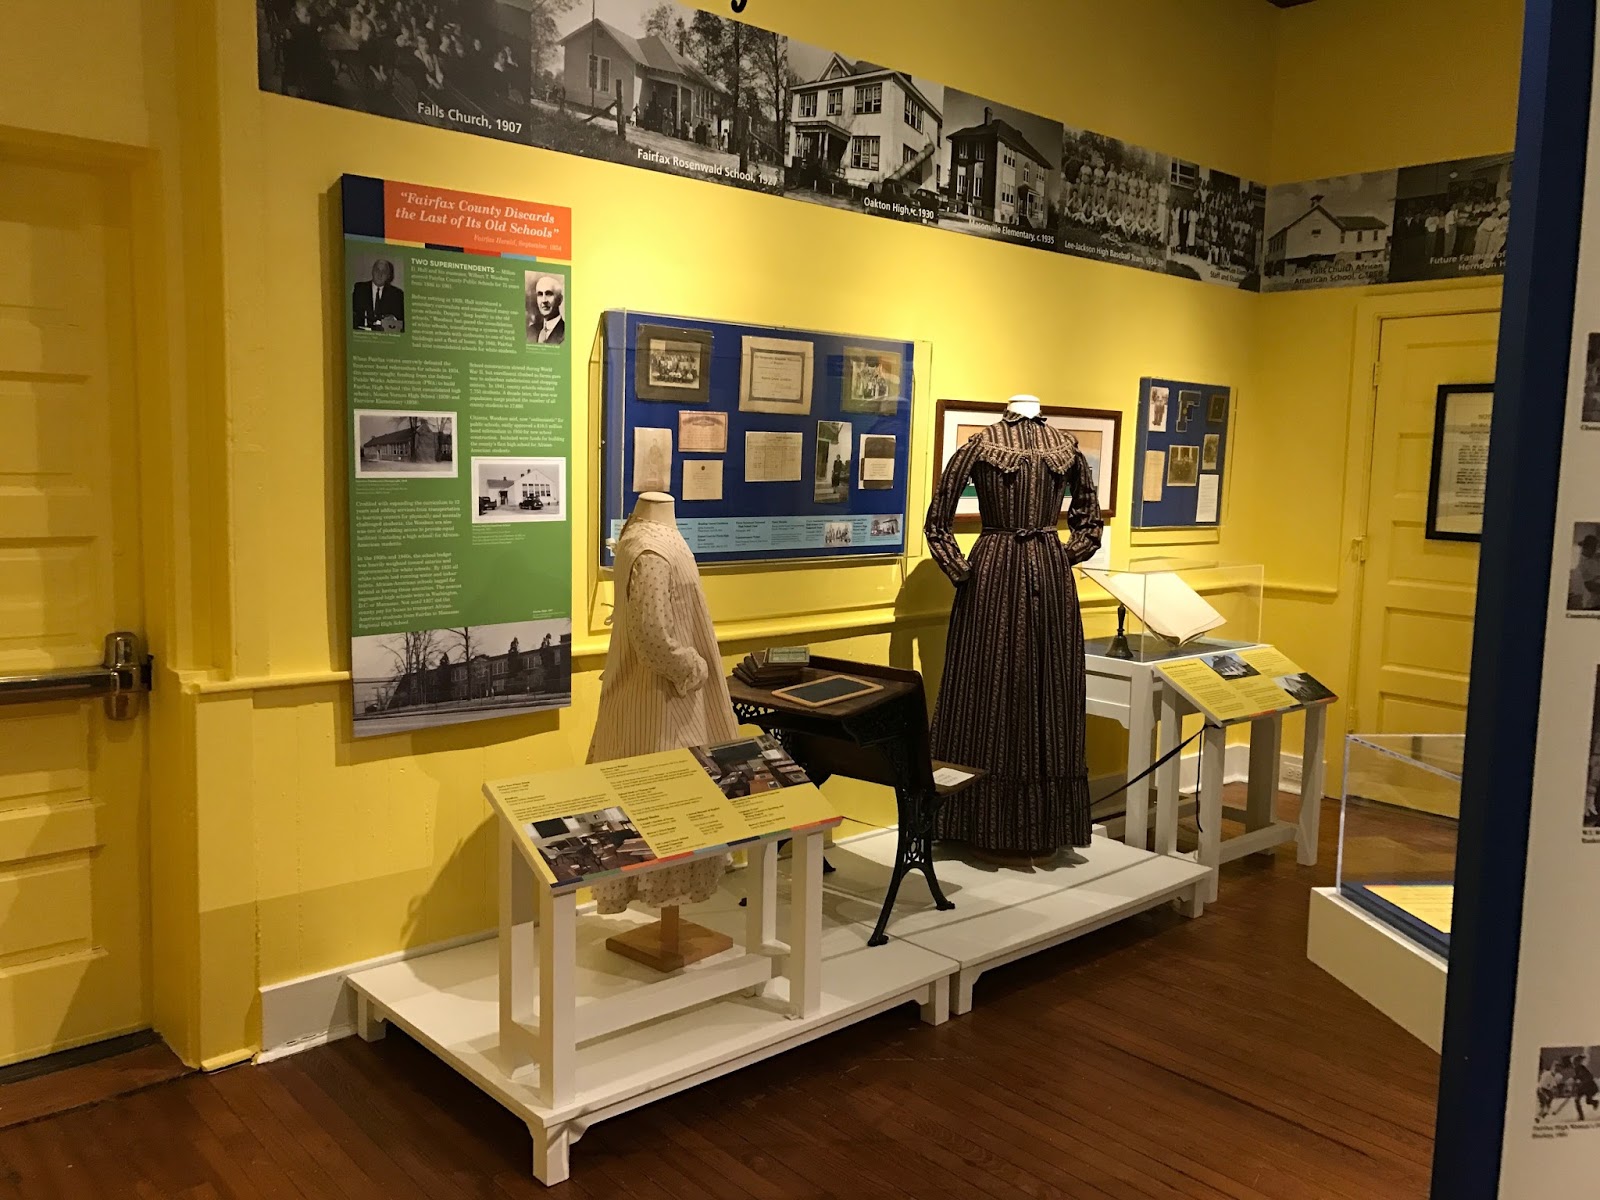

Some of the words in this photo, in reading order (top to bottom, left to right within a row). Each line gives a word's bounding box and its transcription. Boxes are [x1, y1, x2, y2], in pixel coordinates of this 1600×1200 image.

[418, 102, 444, 118] Falls
[448, 109, 492, 129] Church,
[496, 119, 522, 134] 1907
[638, 148, 670, 165] Fairfax
[673, 156, 722, 175] Rosenwald
[725, 167, 755, 183] School,
[401, 192, 455, 209] “Fairfax
[459, 200, 501, 217] County
[505, 207, 554, 224] Discards
[864, 197, 890, 211] Oakton
[893, 203, 910, 216] High,
[396, 208, 416, 220] the
[420, 210, 447, 224] Last
[451, 215, 464, 228] of
[466, 217, 481, 228] Its
[485, 219, 506, 232] Old
[510, 222, 559, 238] Schools”
[1003, 226, 1035, 242] Elementary,
[1065, 241, 1095, 253] Lee-Jackson
[1097, 247, 1108, 257] High
[1110, 250, 1130, 260] Baseball
[430, 260, 495, 273] SUPERINTENDENTS
